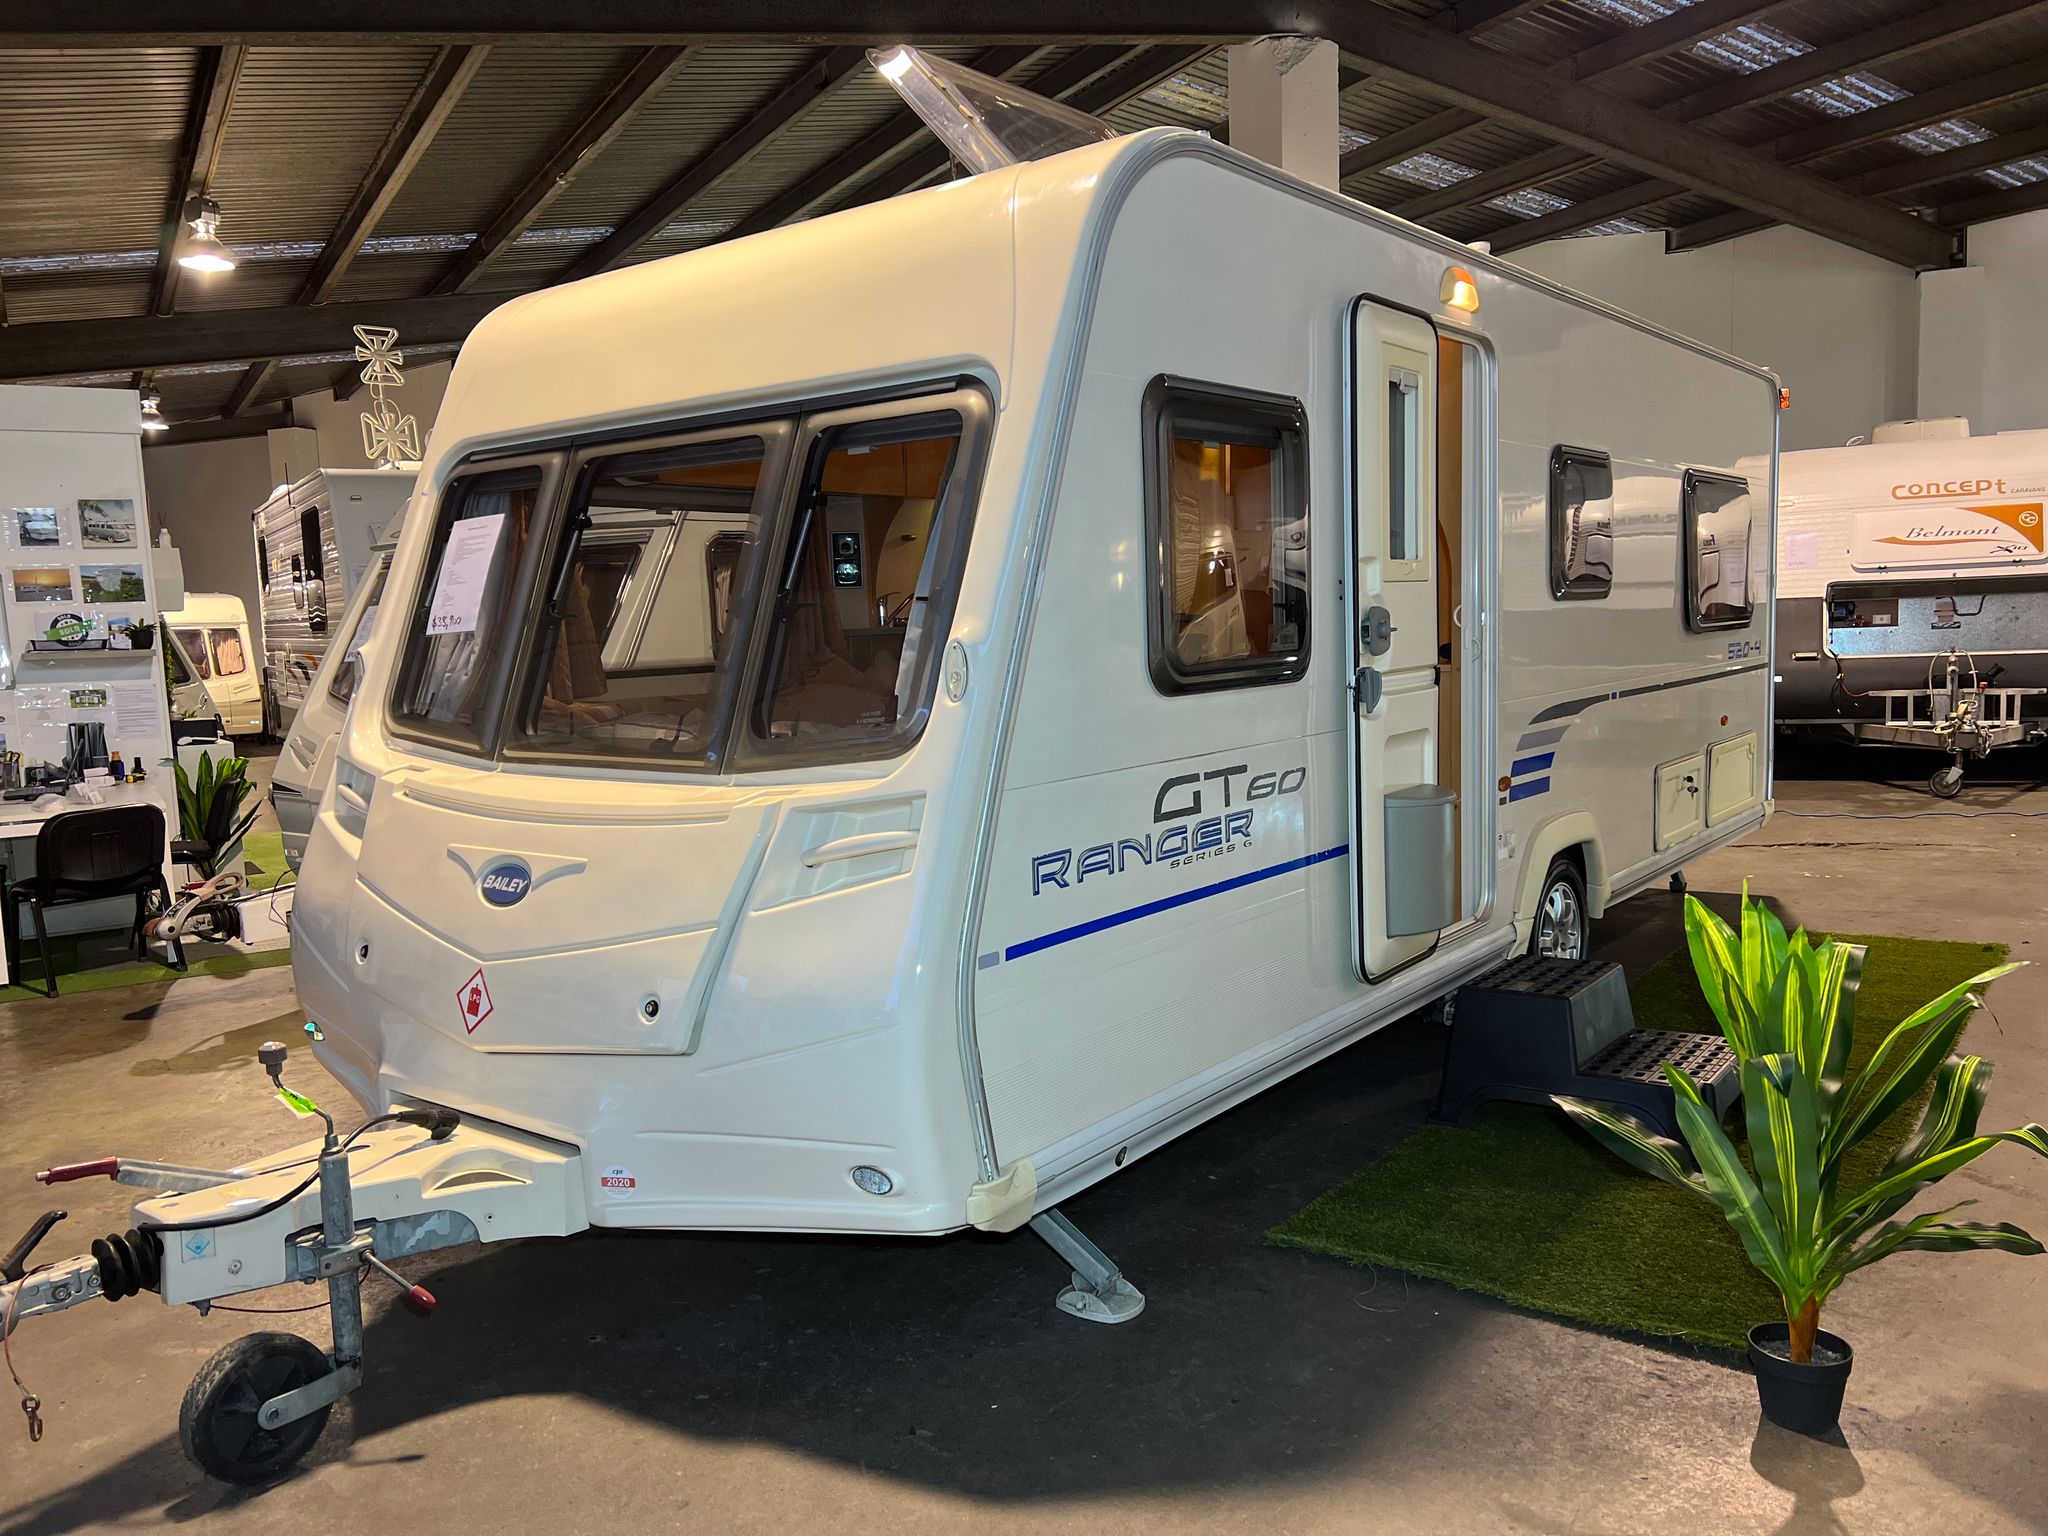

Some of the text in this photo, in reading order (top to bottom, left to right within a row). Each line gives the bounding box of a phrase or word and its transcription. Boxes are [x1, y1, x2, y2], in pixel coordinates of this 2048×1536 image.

[2010, 486, 2045, 494] CARAVANS
[1904, 525, 2000, 539] Belmont
[59, 625, 80, 636] SOLD
[1728, 640, 1761, 659] 520-4
[1031, 808, 1253, 896] RANGER
[1170, 840, 1253, 869] SERIES 6
[483, 874, 527, 893] BAILEY
[469, 993, 480, 1003] LPG
[606, 1178, 630, 1187] 2020
